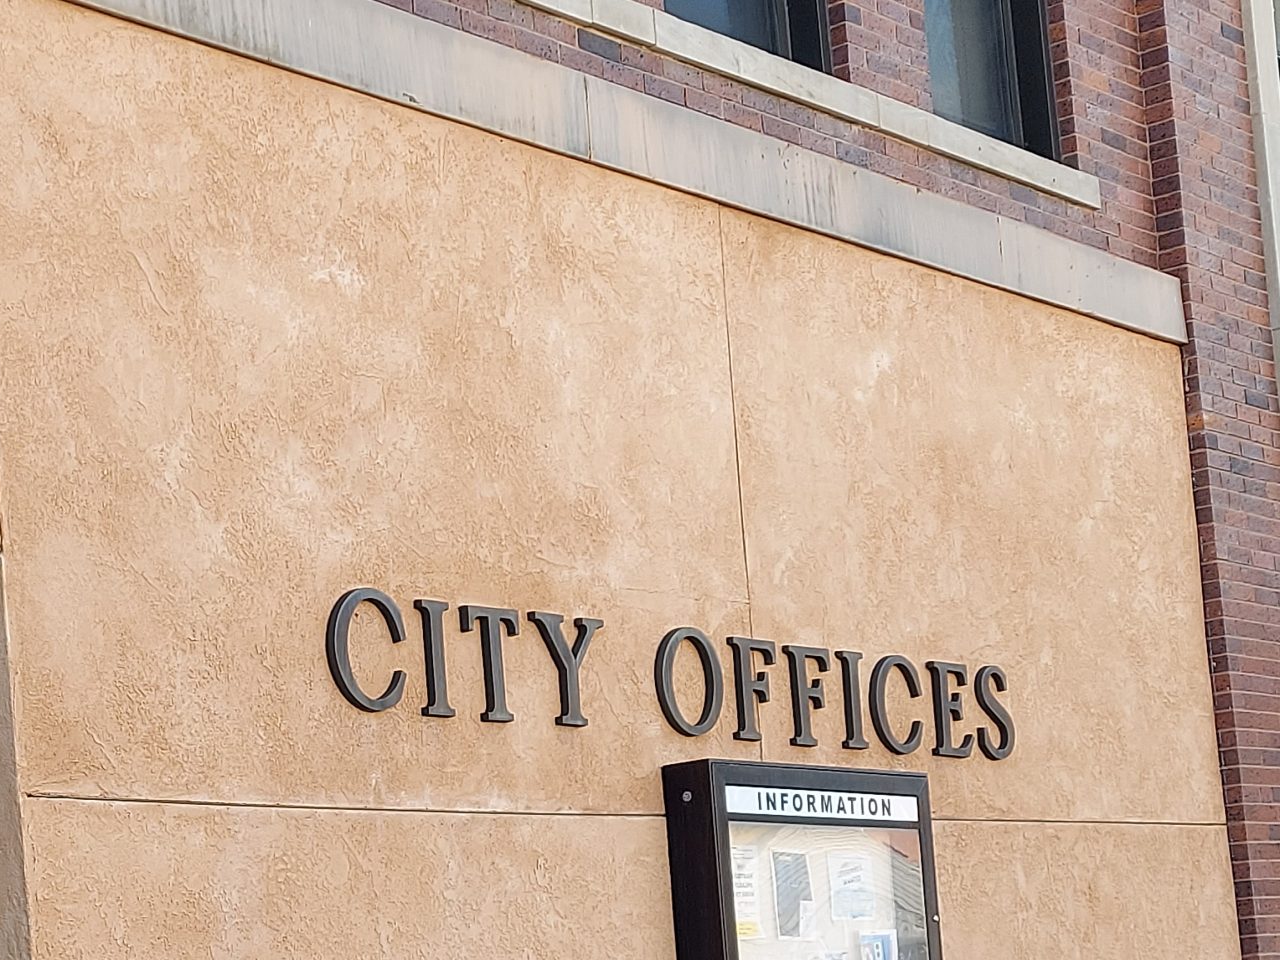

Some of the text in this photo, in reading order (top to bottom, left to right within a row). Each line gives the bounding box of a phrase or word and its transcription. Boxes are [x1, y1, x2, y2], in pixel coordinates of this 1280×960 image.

[325, 587, 1016, 761] CITY OFFICES
[757, 791, 893, 817] INFORMATION
